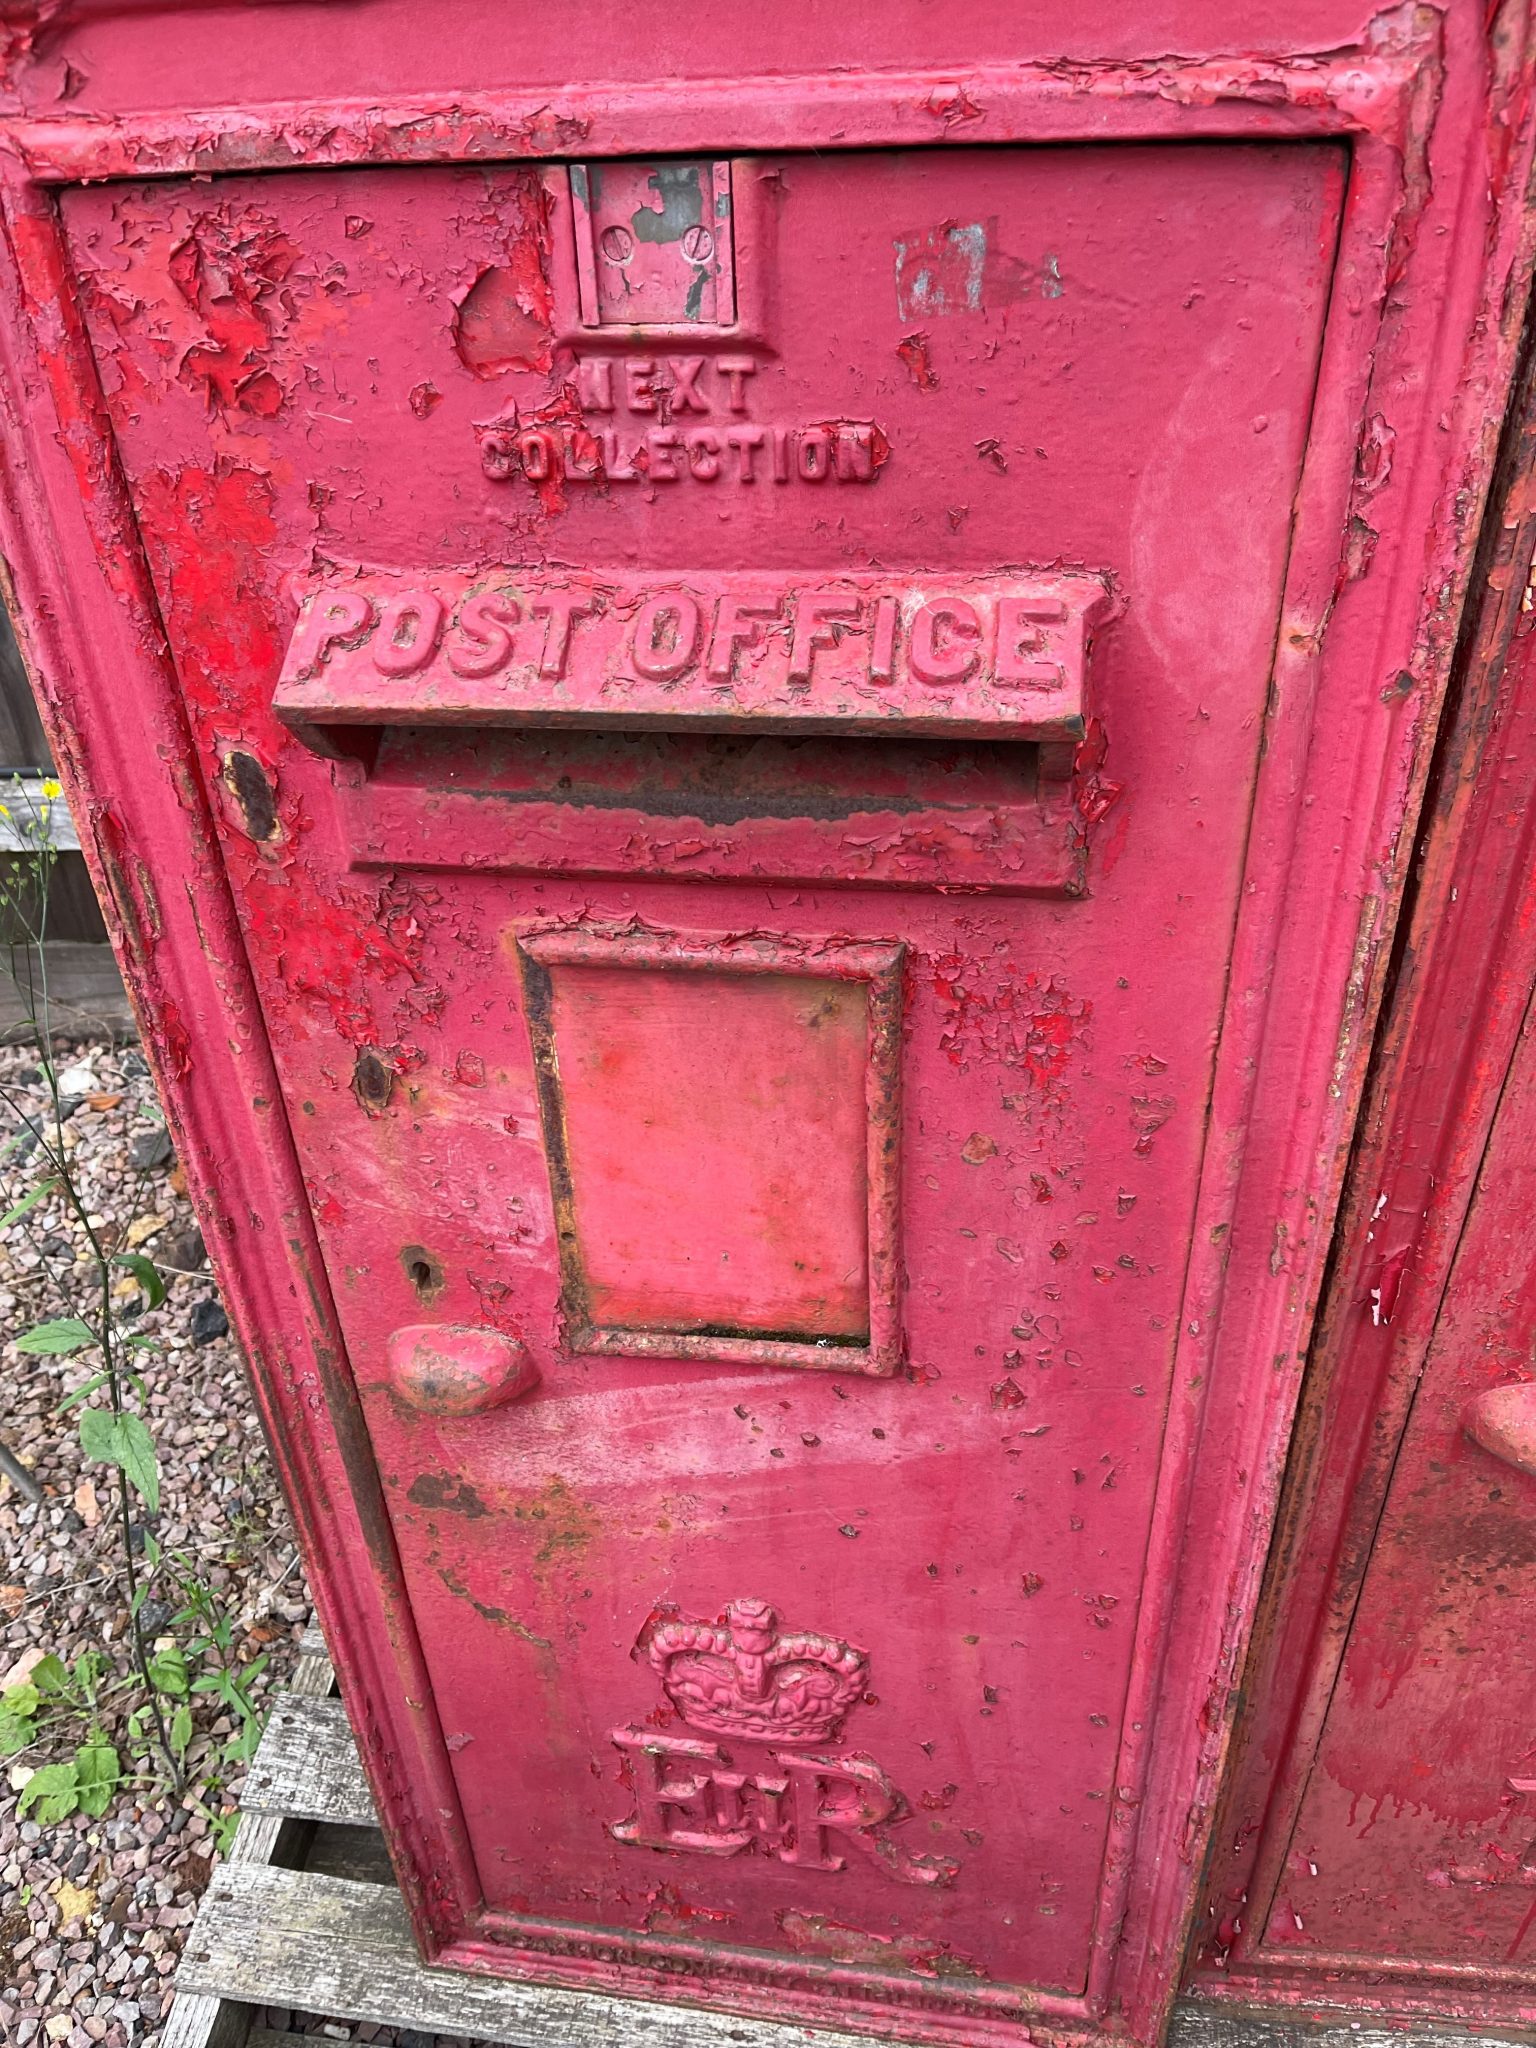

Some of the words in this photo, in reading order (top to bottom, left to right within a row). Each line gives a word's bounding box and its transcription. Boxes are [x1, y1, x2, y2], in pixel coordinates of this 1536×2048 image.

[579, 357, 757, 411] NEXT
[479, 426, 876, 483] COLLECTION
[295, 590, 592, 682] POST
[633, 592, 1063, 688] OFFICE
